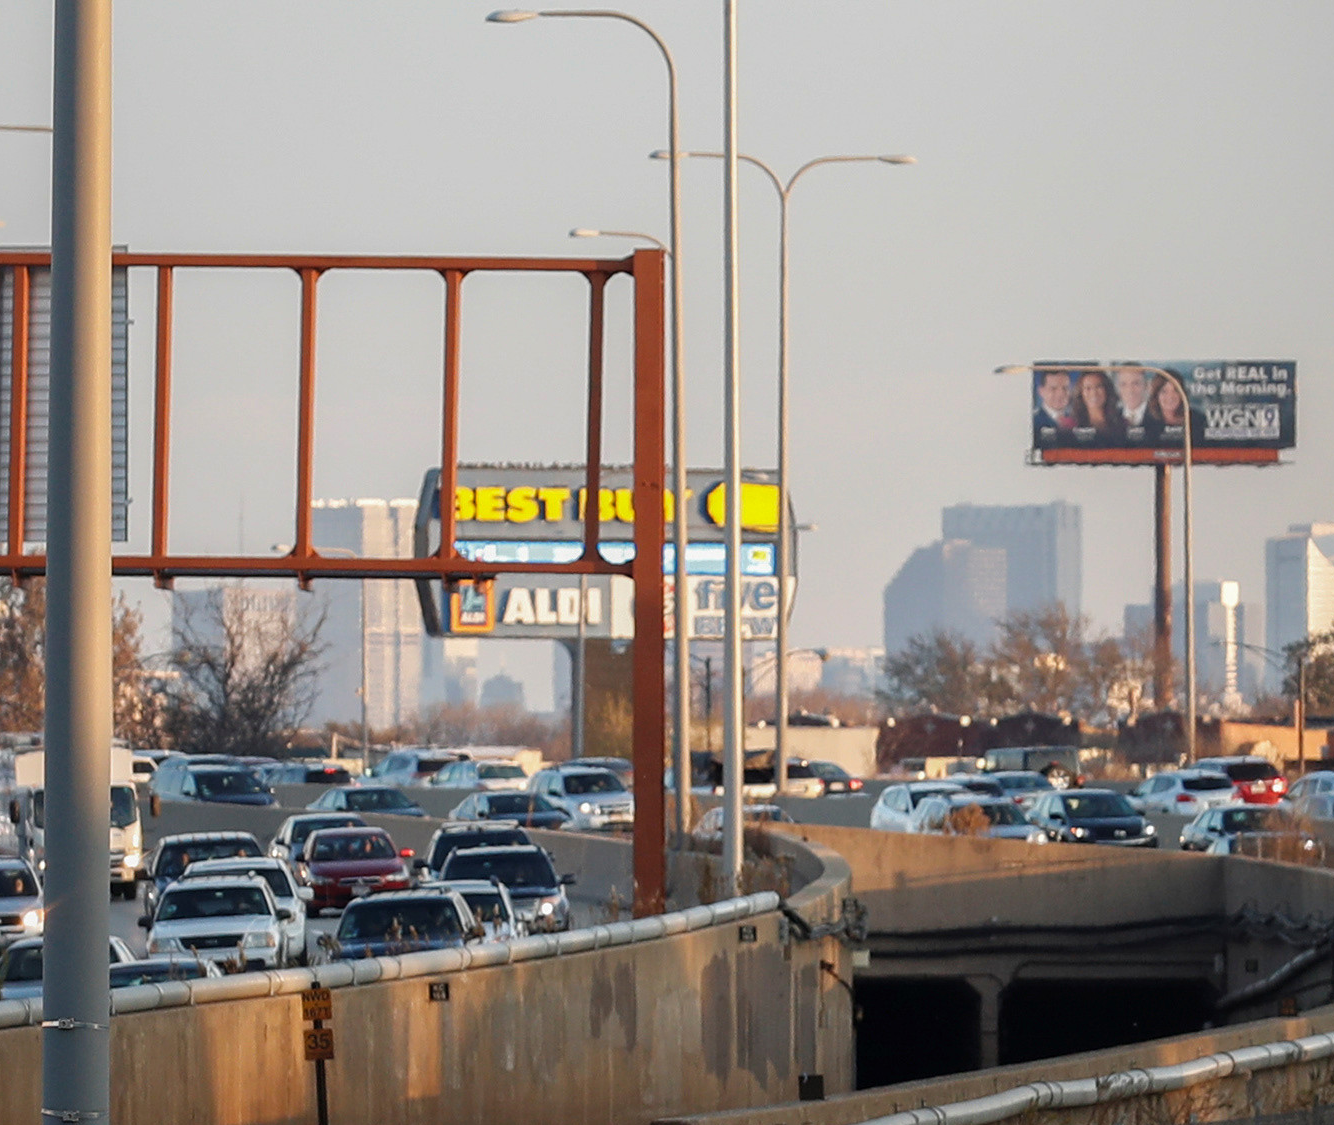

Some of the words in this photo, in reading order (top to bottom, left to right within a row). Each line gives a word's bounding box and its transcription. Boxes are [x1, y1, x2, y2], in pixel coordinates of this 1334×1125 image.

[1194, 367, 1221, 379] Get
[1225, 366, 1268, 379] REAL
[1191, 382, 1217, 395] the
[454, 486, 571, 523] BEST
[503, 587, 602, 626] ALDI
[307, 1033, 330, 1050] 35
